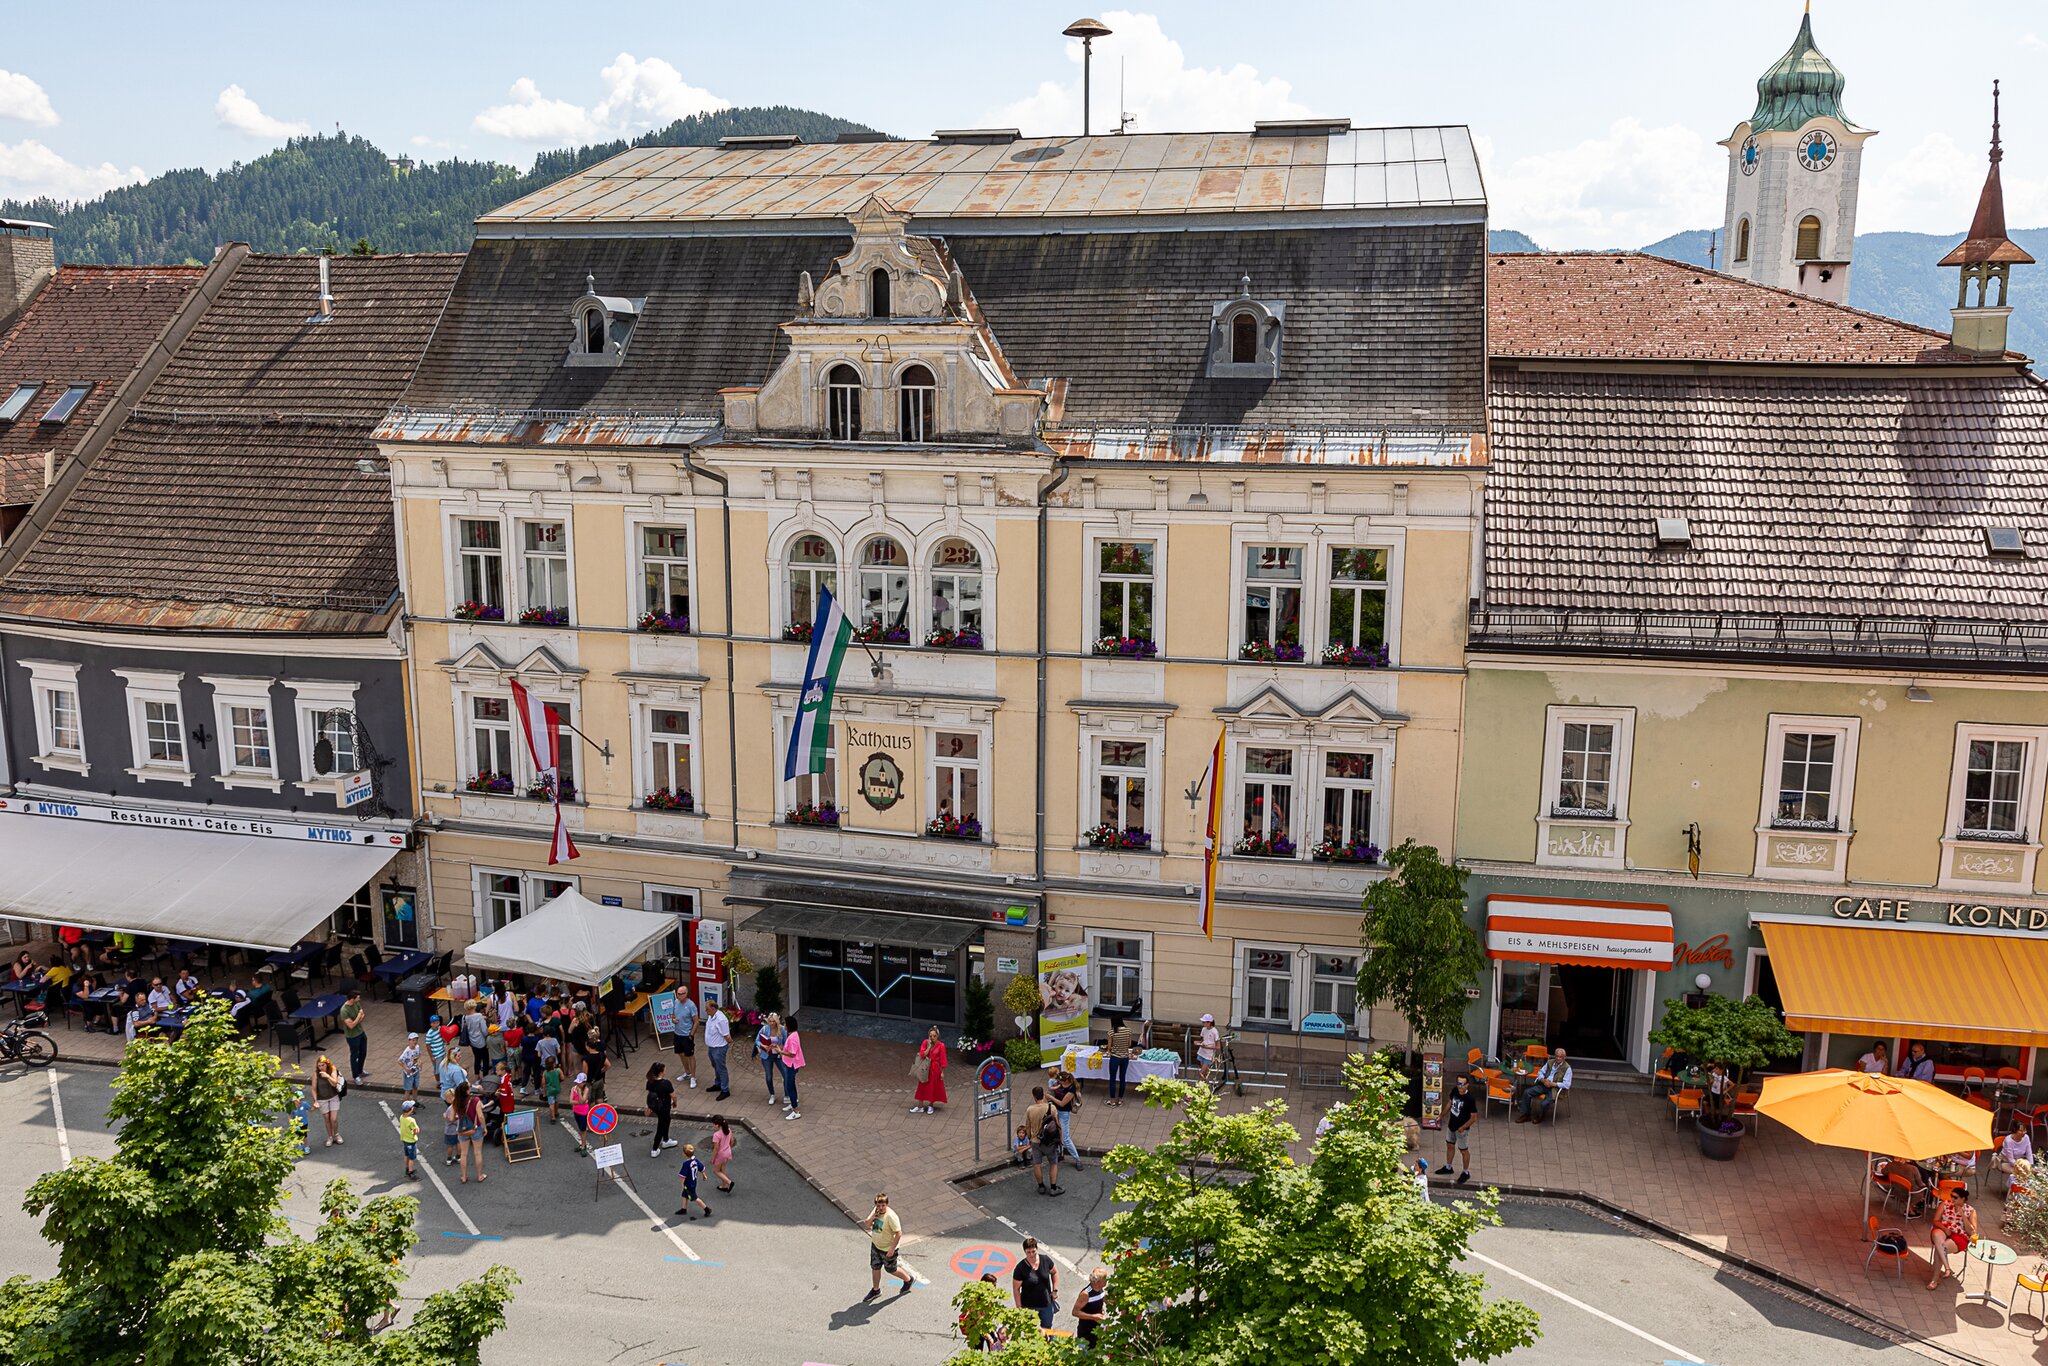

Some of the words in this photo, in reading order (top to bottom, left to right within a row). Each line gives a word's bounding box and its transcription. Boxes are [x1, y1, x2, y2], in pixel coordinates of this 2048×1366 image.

[538, 527, 557, 542] 18
[803, 540, 826, 558] 16
[944, 547, 970, 563] 23
[1261, 552, 1287, 570] 21
[484, 701, 501, 717] 15
[847, 726, 912, 750] Rathaus
[950, 737, 963, 756] 9
[346, 786, 372, 804] MYTHOS
[38, 802, 78, 817] MYTHOS
[110, 810, 194, 828] Restaurant
[204, 818, 238, 832] Cafe
[250, 822, 274, 835] Eis
[308, 826, 352, 842] MYTHOS
[1834, 896, 1911, 922] CAFE
[1948, 904, 2048, 931] KOND
[1508, 938, 1522, 946] EIS
[1526, 939, 1533, 947] &
[1538, 940, 1600, 952] MEHLSPEISEN
[1606, 946, 1652, 954] hausgemacht
[1256, 951, 1284, 969] 22
[1330, 958, 1343, 974] 3
